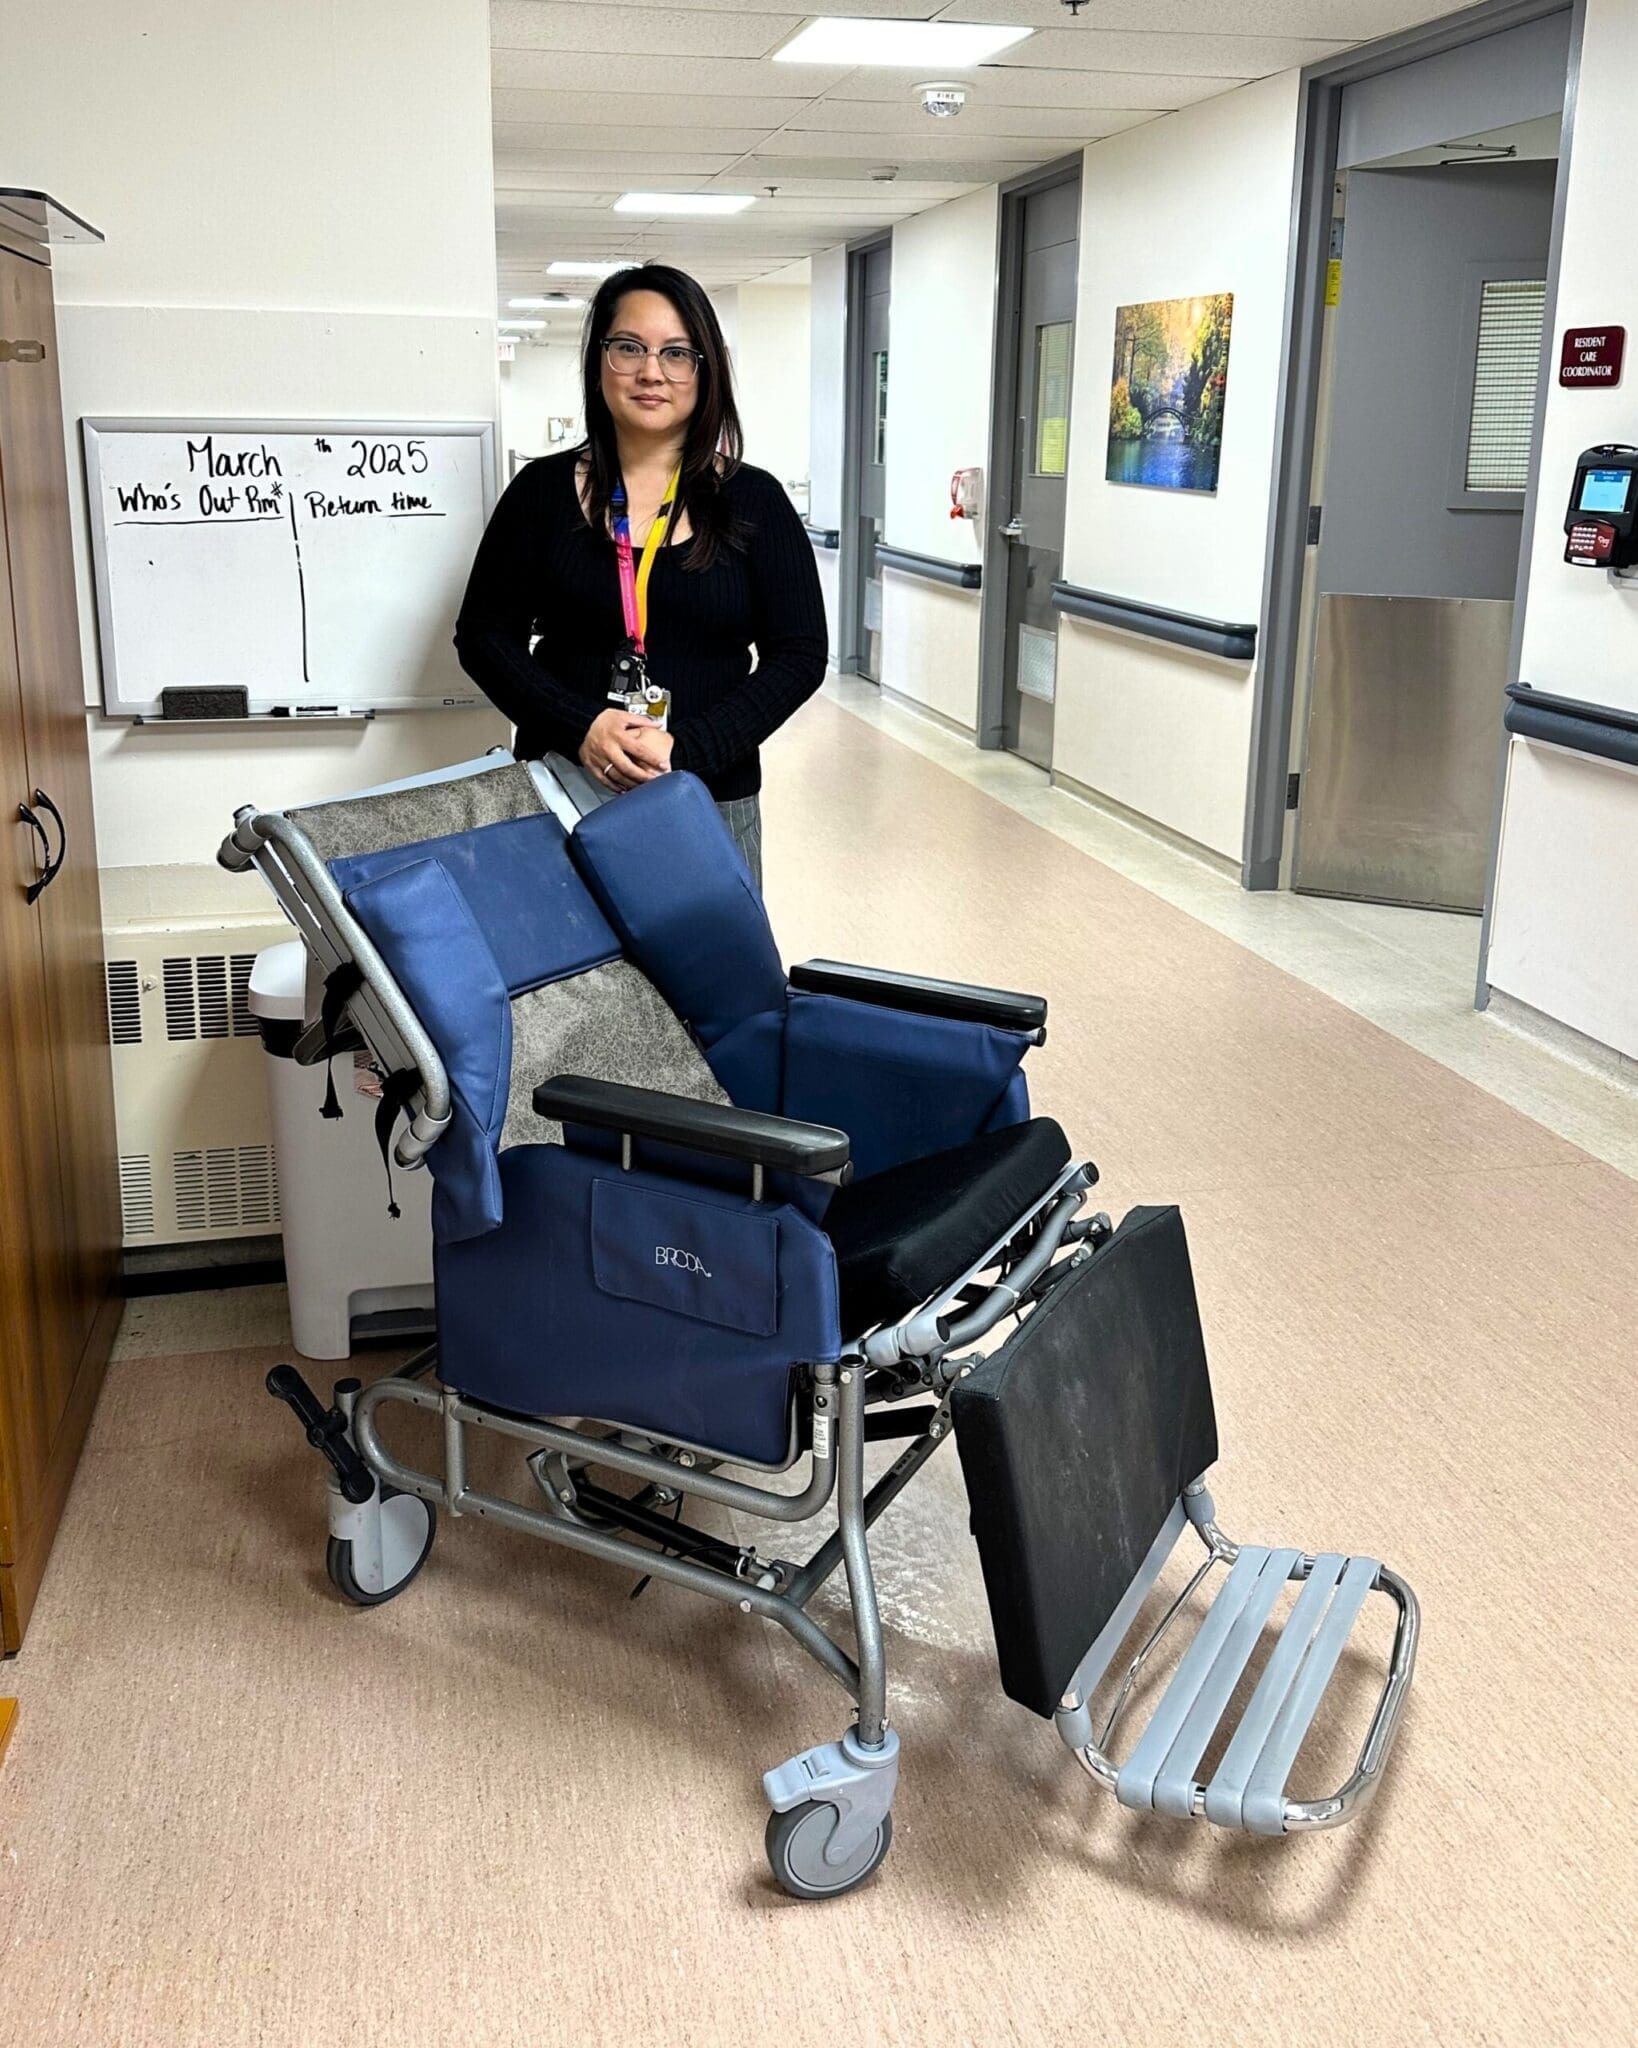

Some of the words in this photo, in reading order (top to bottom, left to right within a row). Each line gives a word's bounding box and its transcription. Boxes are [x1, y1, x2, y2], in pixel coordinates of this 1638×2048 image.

[1574, 336, 1606, 348] RESIDENT
[1580, 351, 1597, 362] CARE
[1562, 365, 1612, 377] COORDINATOR
[186, 435, 283, 478] March
[313, 437, 332, 453] th
[347, 440, 428, 478] 2025
[117, 482, 182, 512] Who's
[199, 484, 241, 516] Out
[303, 490, 382, 519] Return
[391, 491, 432, 510] time
[655, 1246, 709, 1277] BRODA
